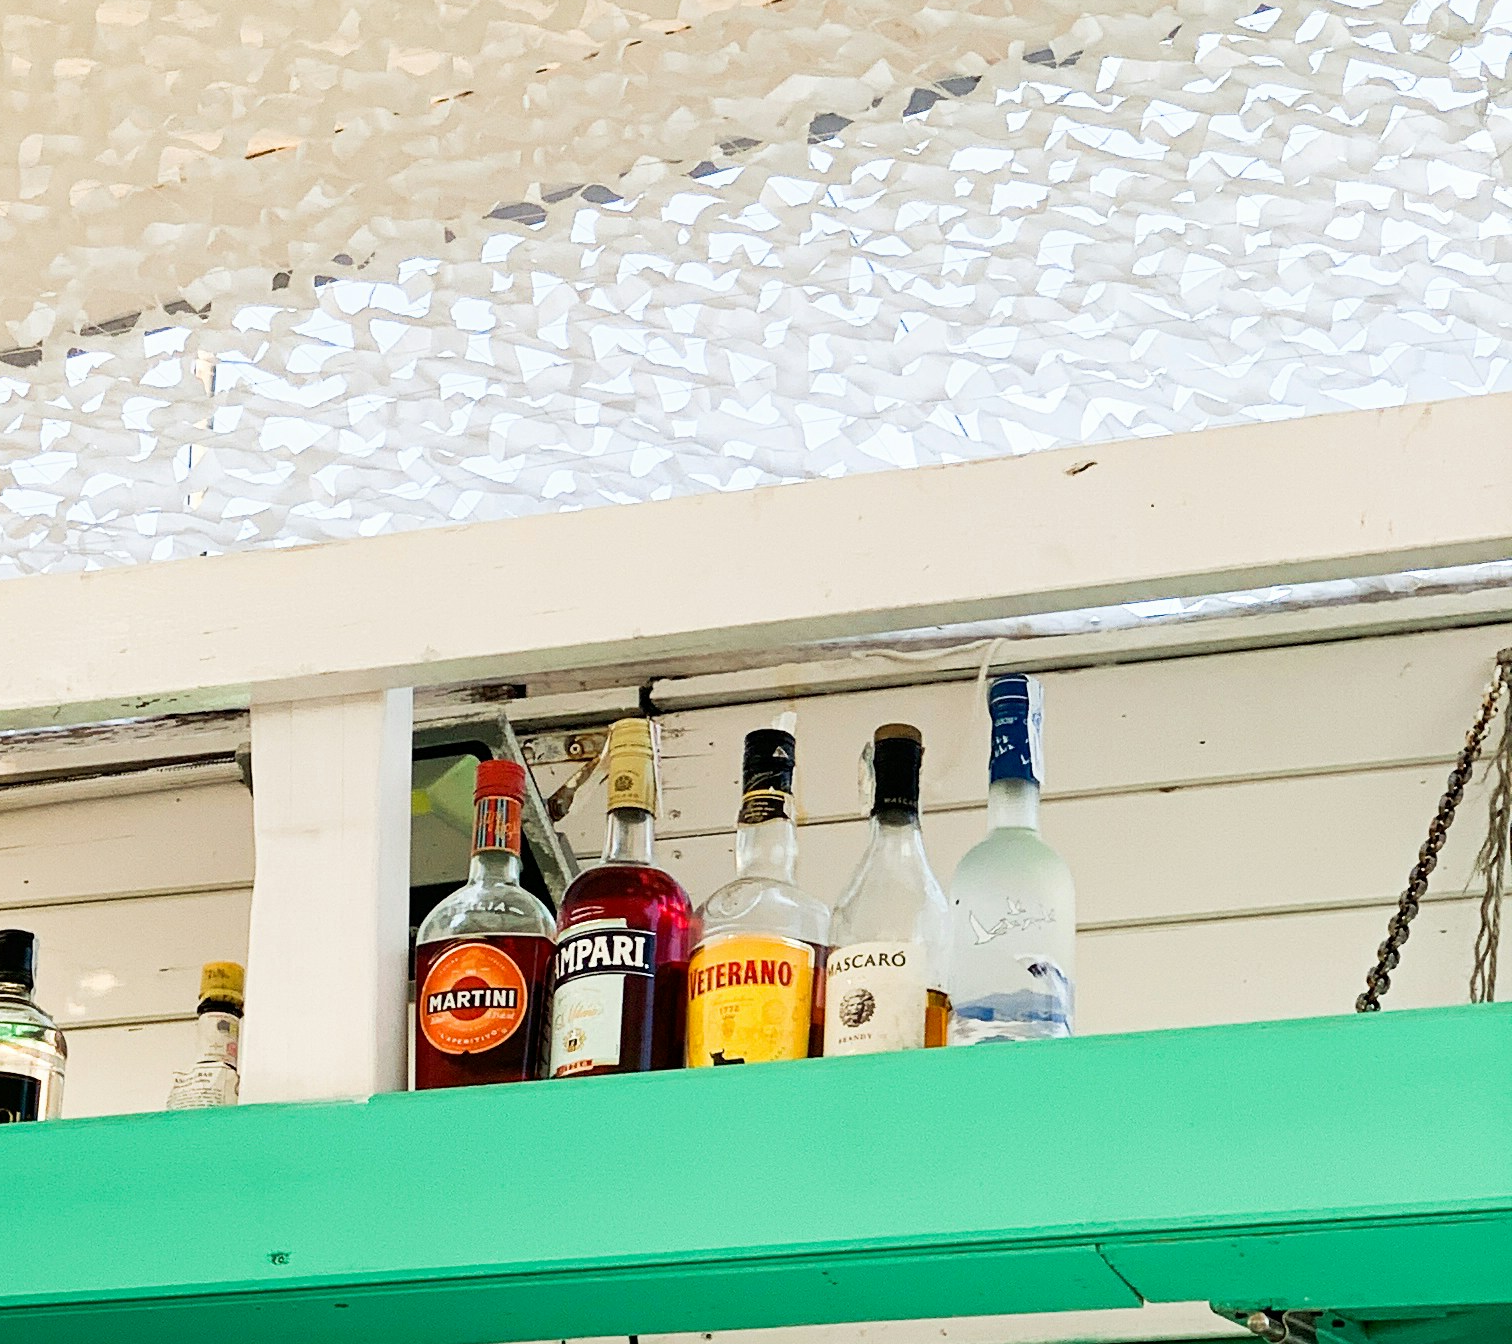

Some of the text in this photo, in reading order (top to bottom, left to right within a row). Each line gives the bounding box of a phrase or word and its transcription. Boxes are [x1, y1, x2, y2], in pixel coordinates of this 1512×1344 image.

[555, 934, 649, 981] MPARI.
[429, 989, 516, 1013] MARTINI
[689, 959, 793, 1001] VETERANO
